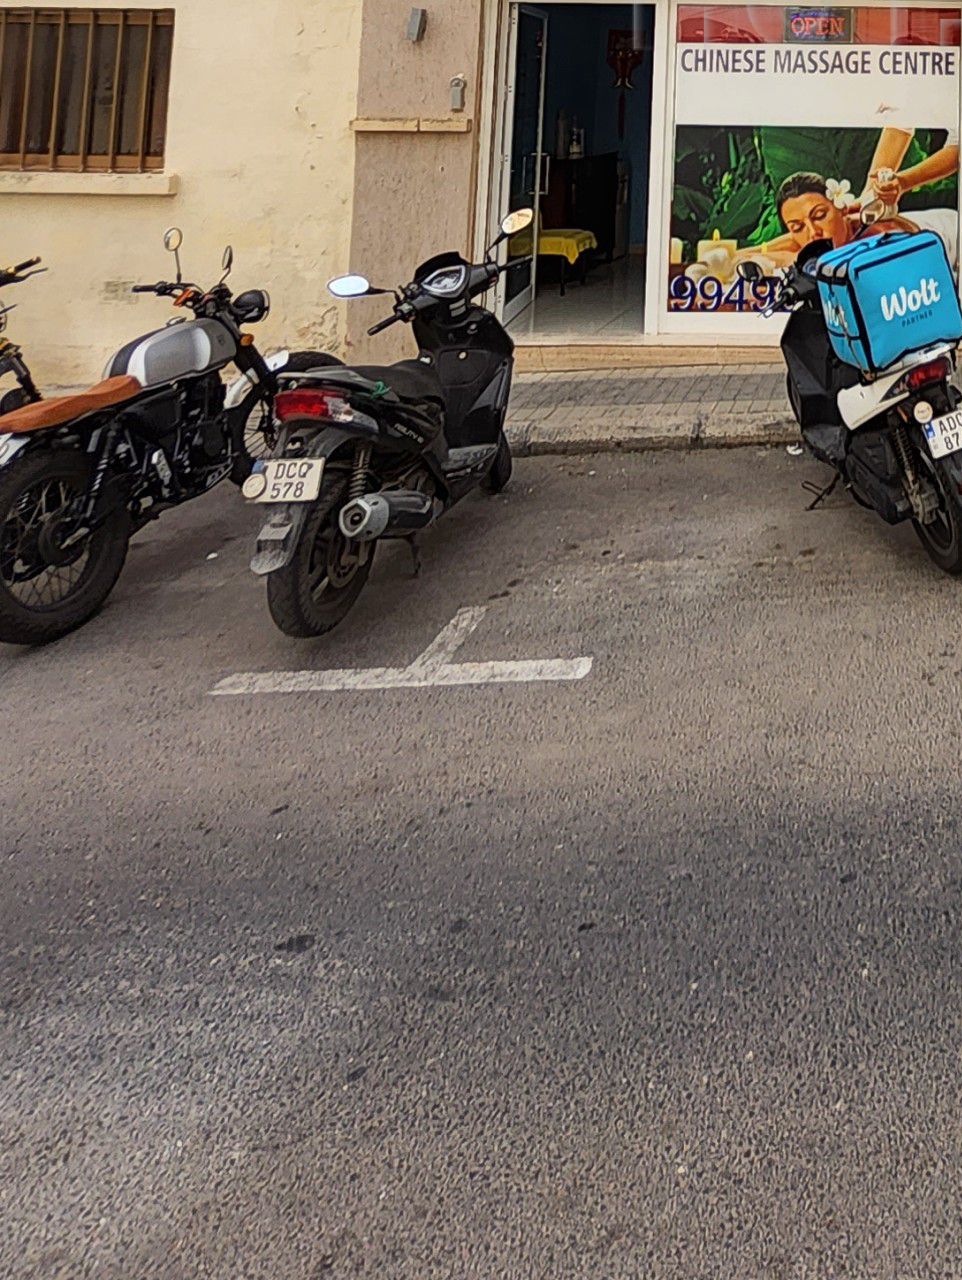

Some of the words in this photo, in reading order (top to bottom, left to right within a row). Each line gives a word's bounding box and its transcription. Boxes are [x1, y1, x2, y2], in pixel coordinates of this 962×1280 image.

[790, 17, 845, 35] OPEN
[681, 48, 766, 73] CHINESE
[773, 49, 871, 75] MASSAGE
[878, 50, 956, 76] CENTRE
[880, 278, 941, 321] Wolt
[270, 481, 305, 499] 578
